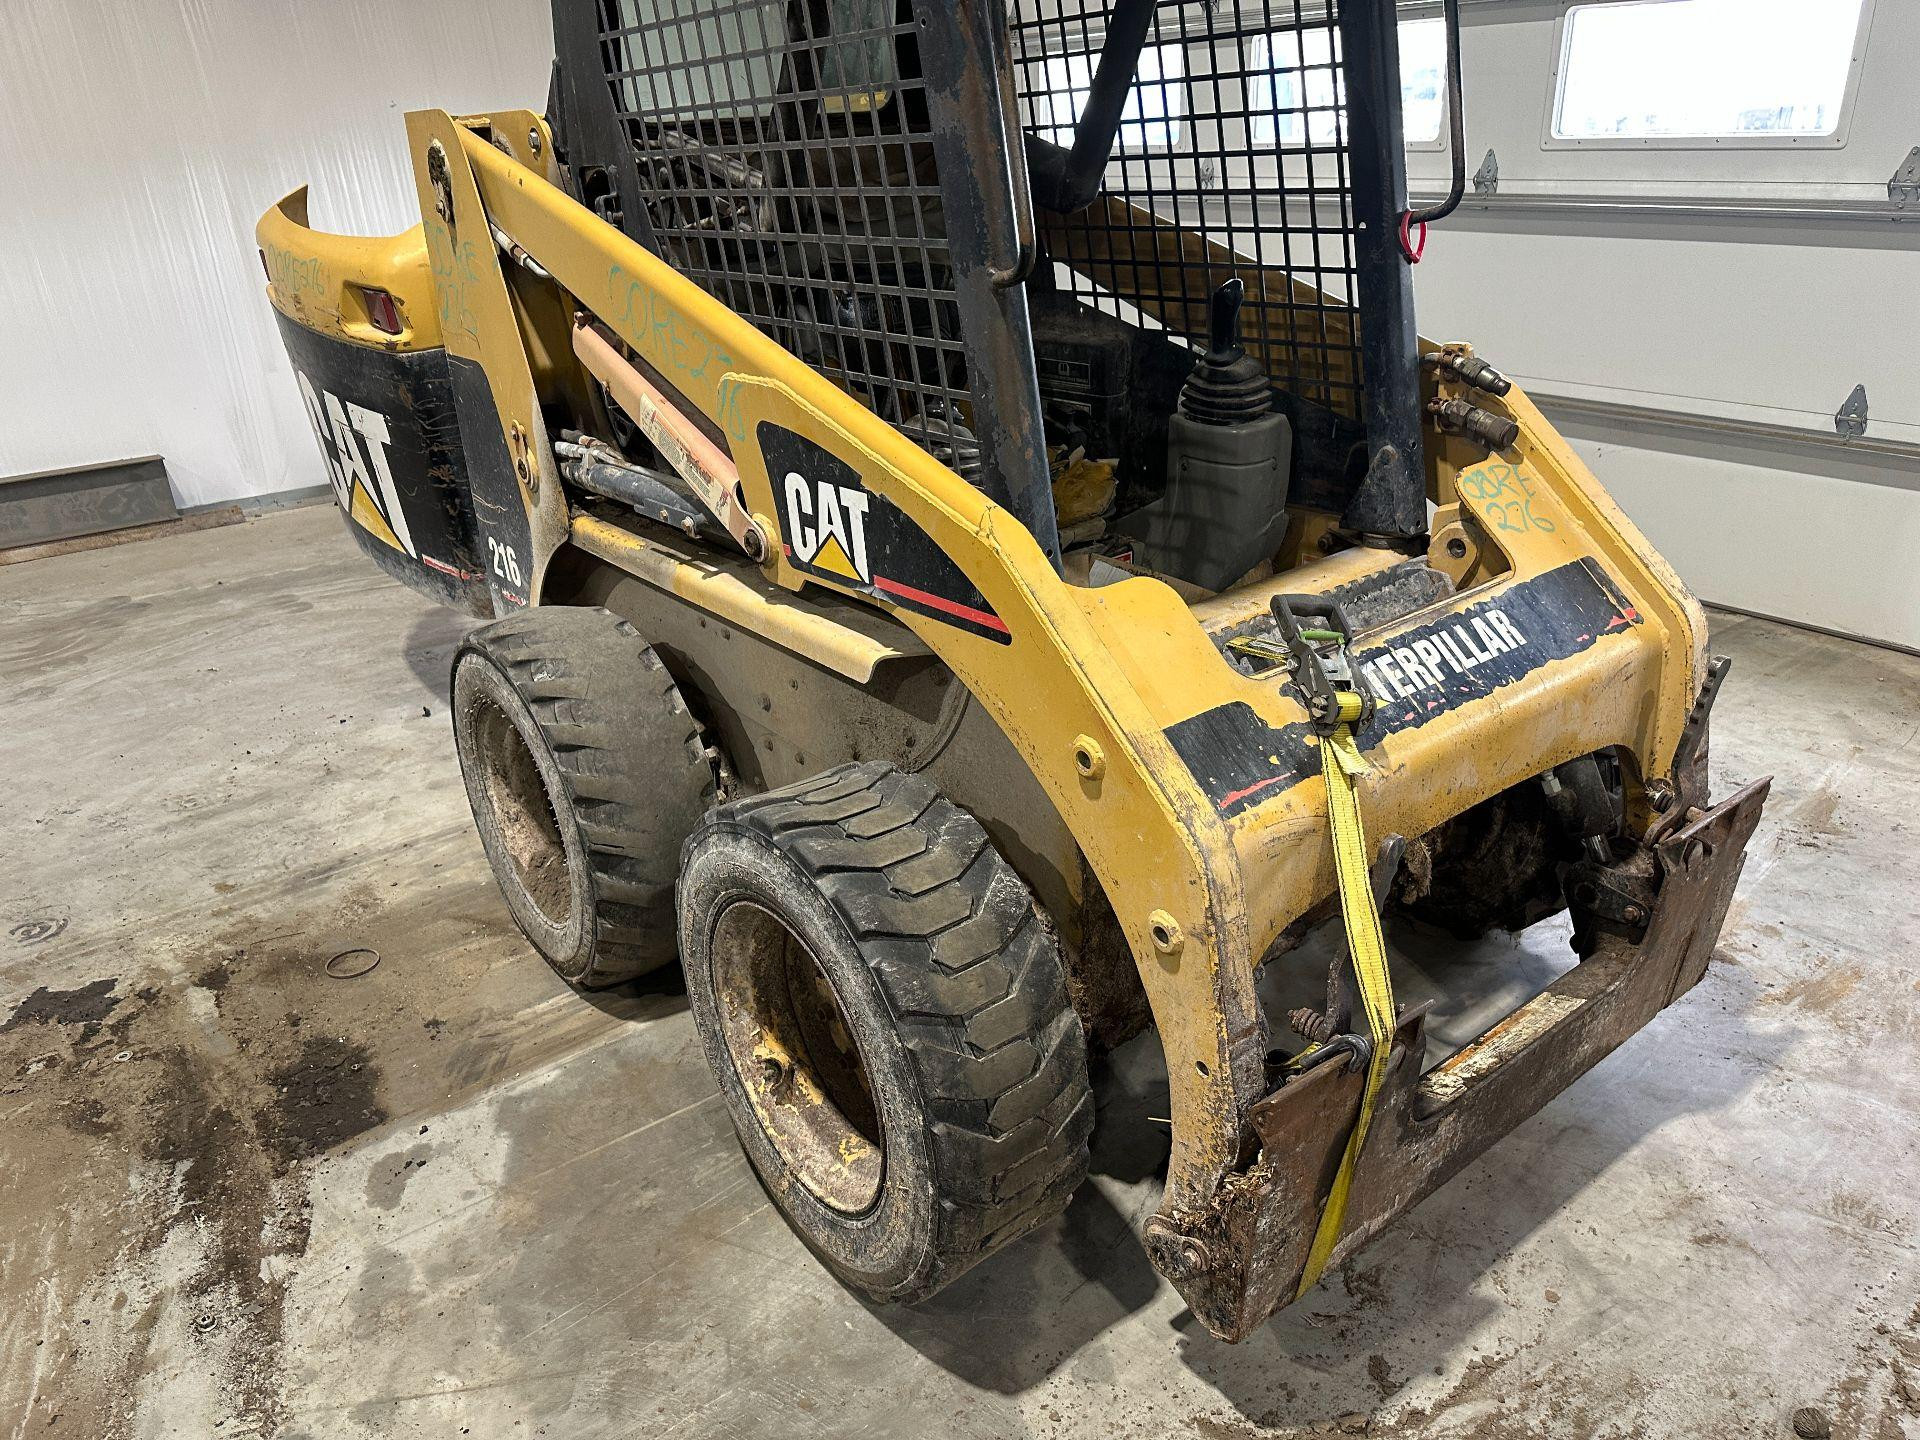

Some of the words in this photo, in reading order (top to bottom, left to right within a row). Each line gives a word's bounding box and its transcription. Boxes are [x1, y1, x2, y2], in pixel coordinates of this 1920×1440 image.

[299, 370, 417, 560] CAT
[488, 536, 521, 588] 216
[784, 472, 870, 584] CAT
[1485, 500, 1556, 534] 276
[1360, 608, 1528, 703] TERPILLAR
